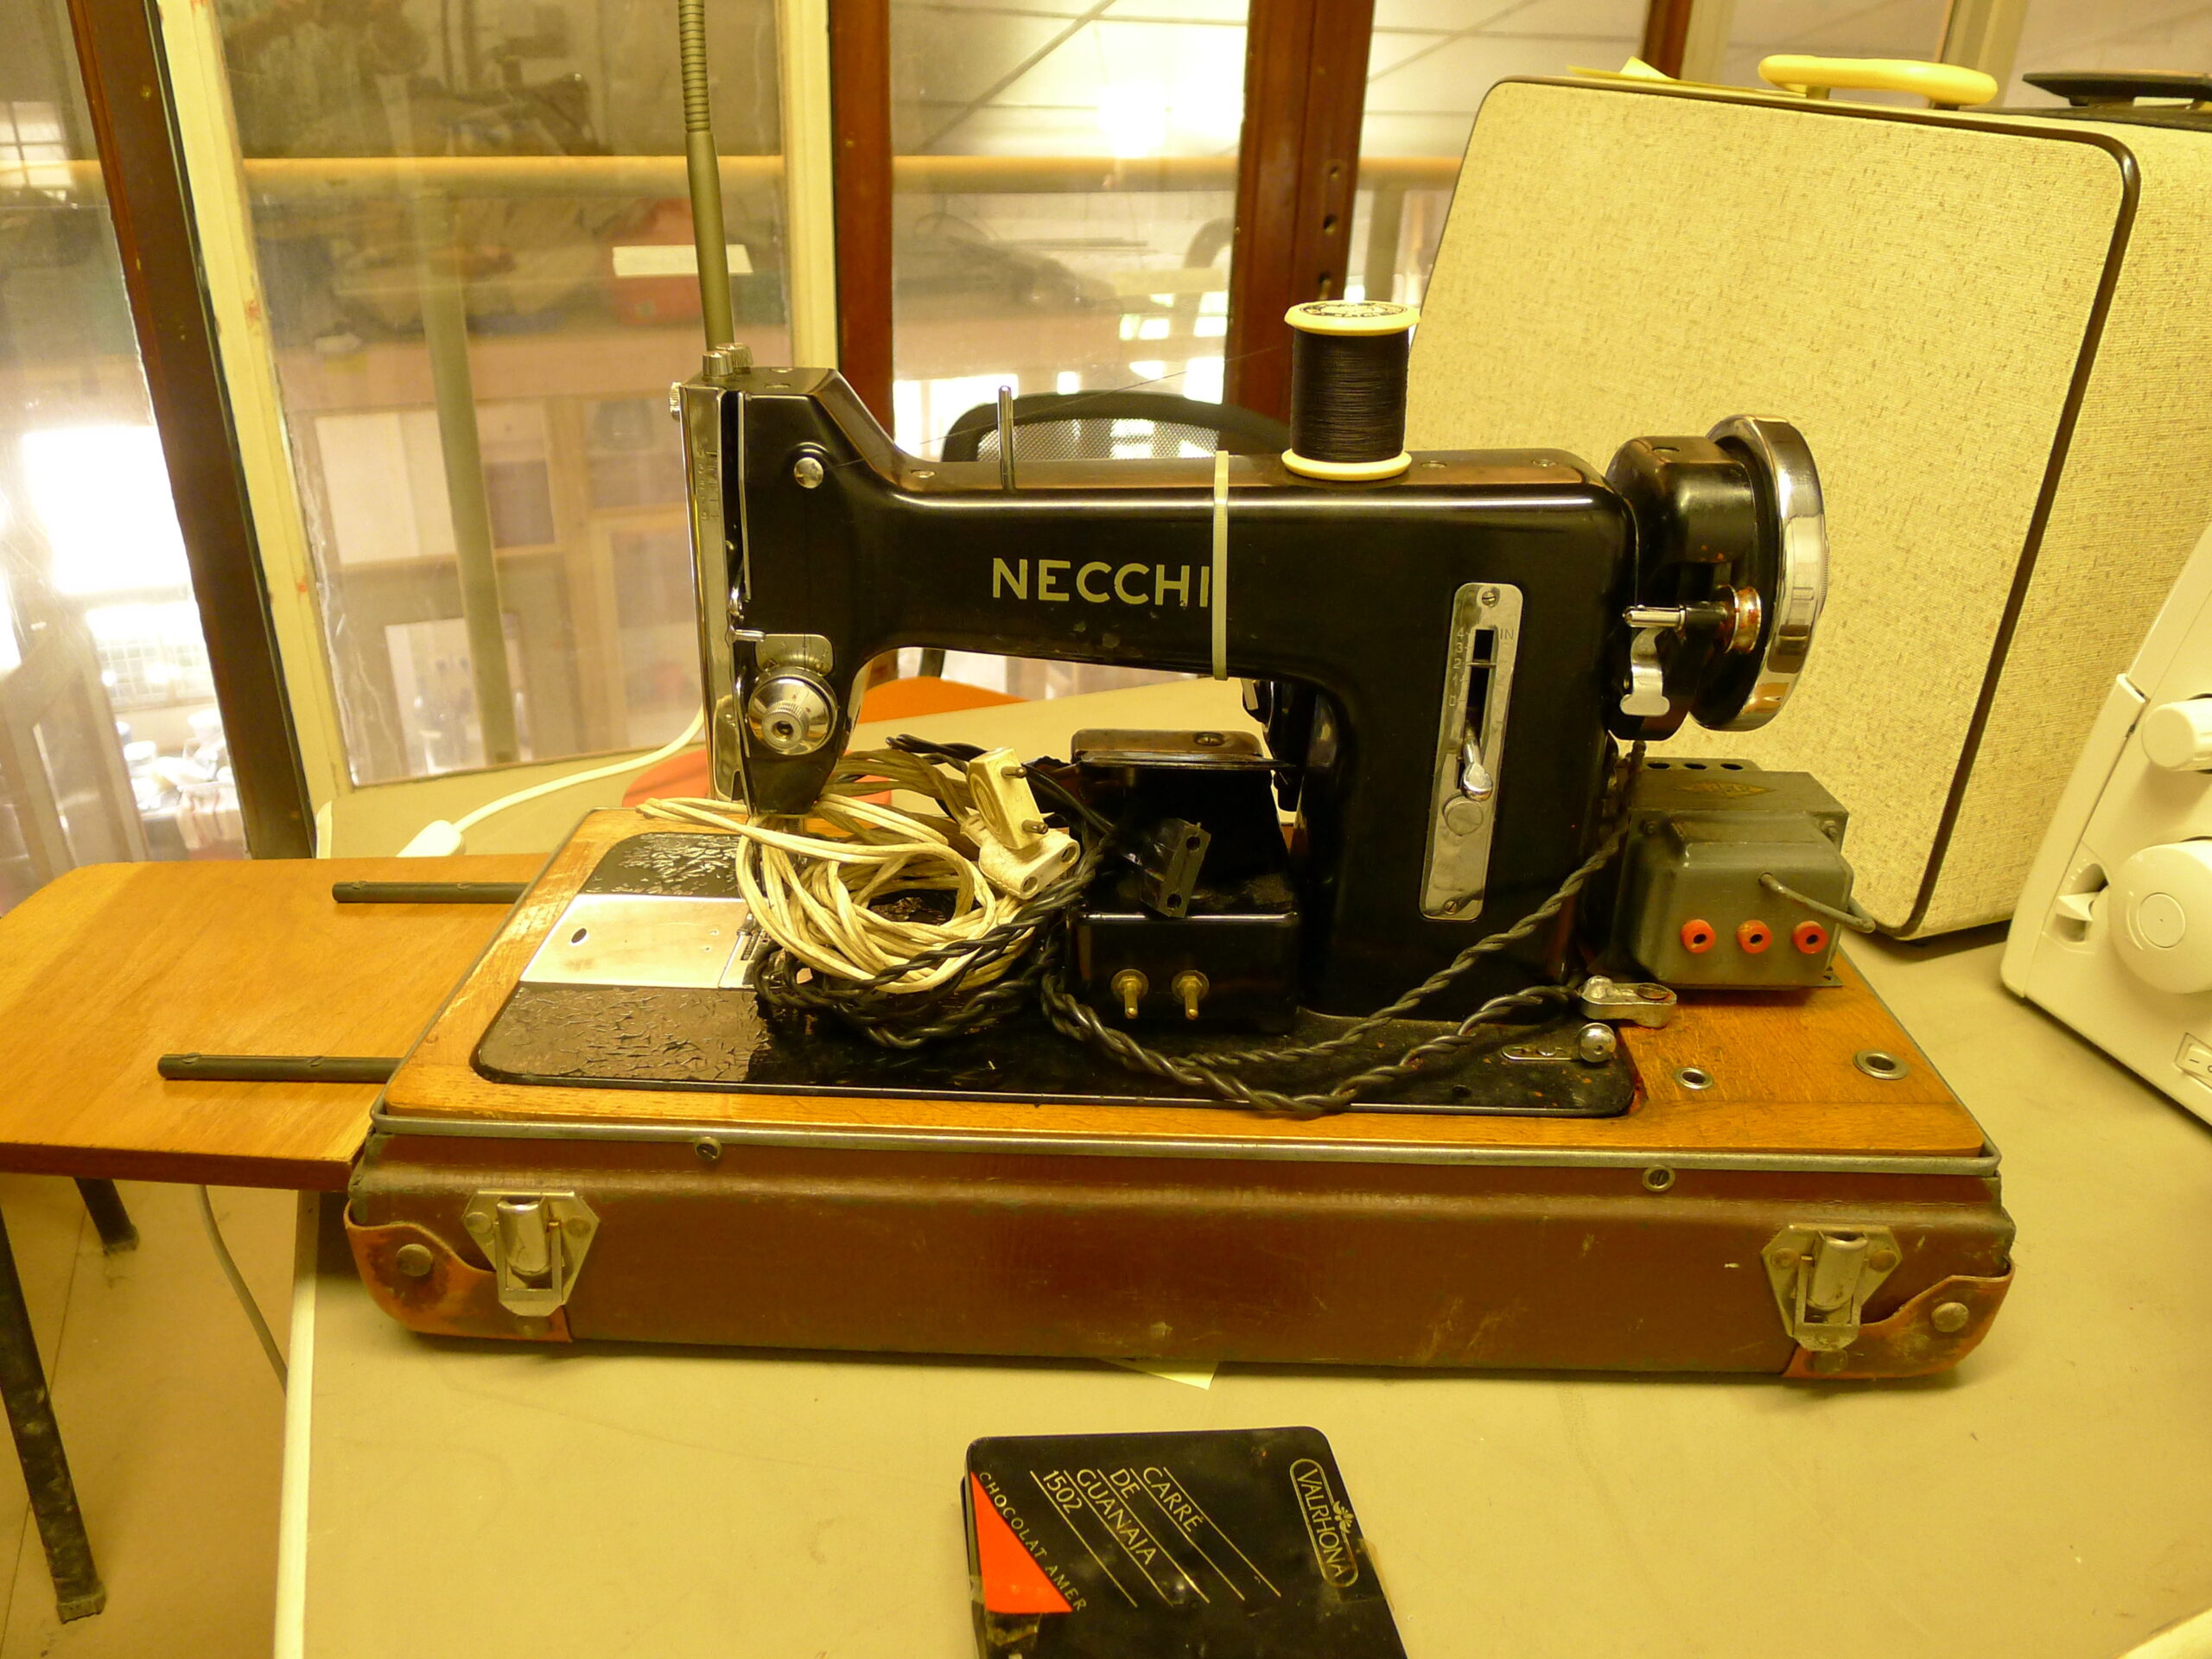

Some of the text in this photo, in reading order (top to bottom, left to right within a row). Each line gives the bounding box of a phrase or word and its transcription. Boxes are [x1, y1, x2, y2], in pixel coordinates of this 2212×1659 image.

[993, 557, 1210, 607] NECCHI
[1042, 1470, 1083, 1515] 1502
[1109, 1467, 1141, 1499] DE
[979, 1471, 1087, 1611] CHOCOLAT AMER
[1297, 1468, 1349, 1577] VALRHONA
